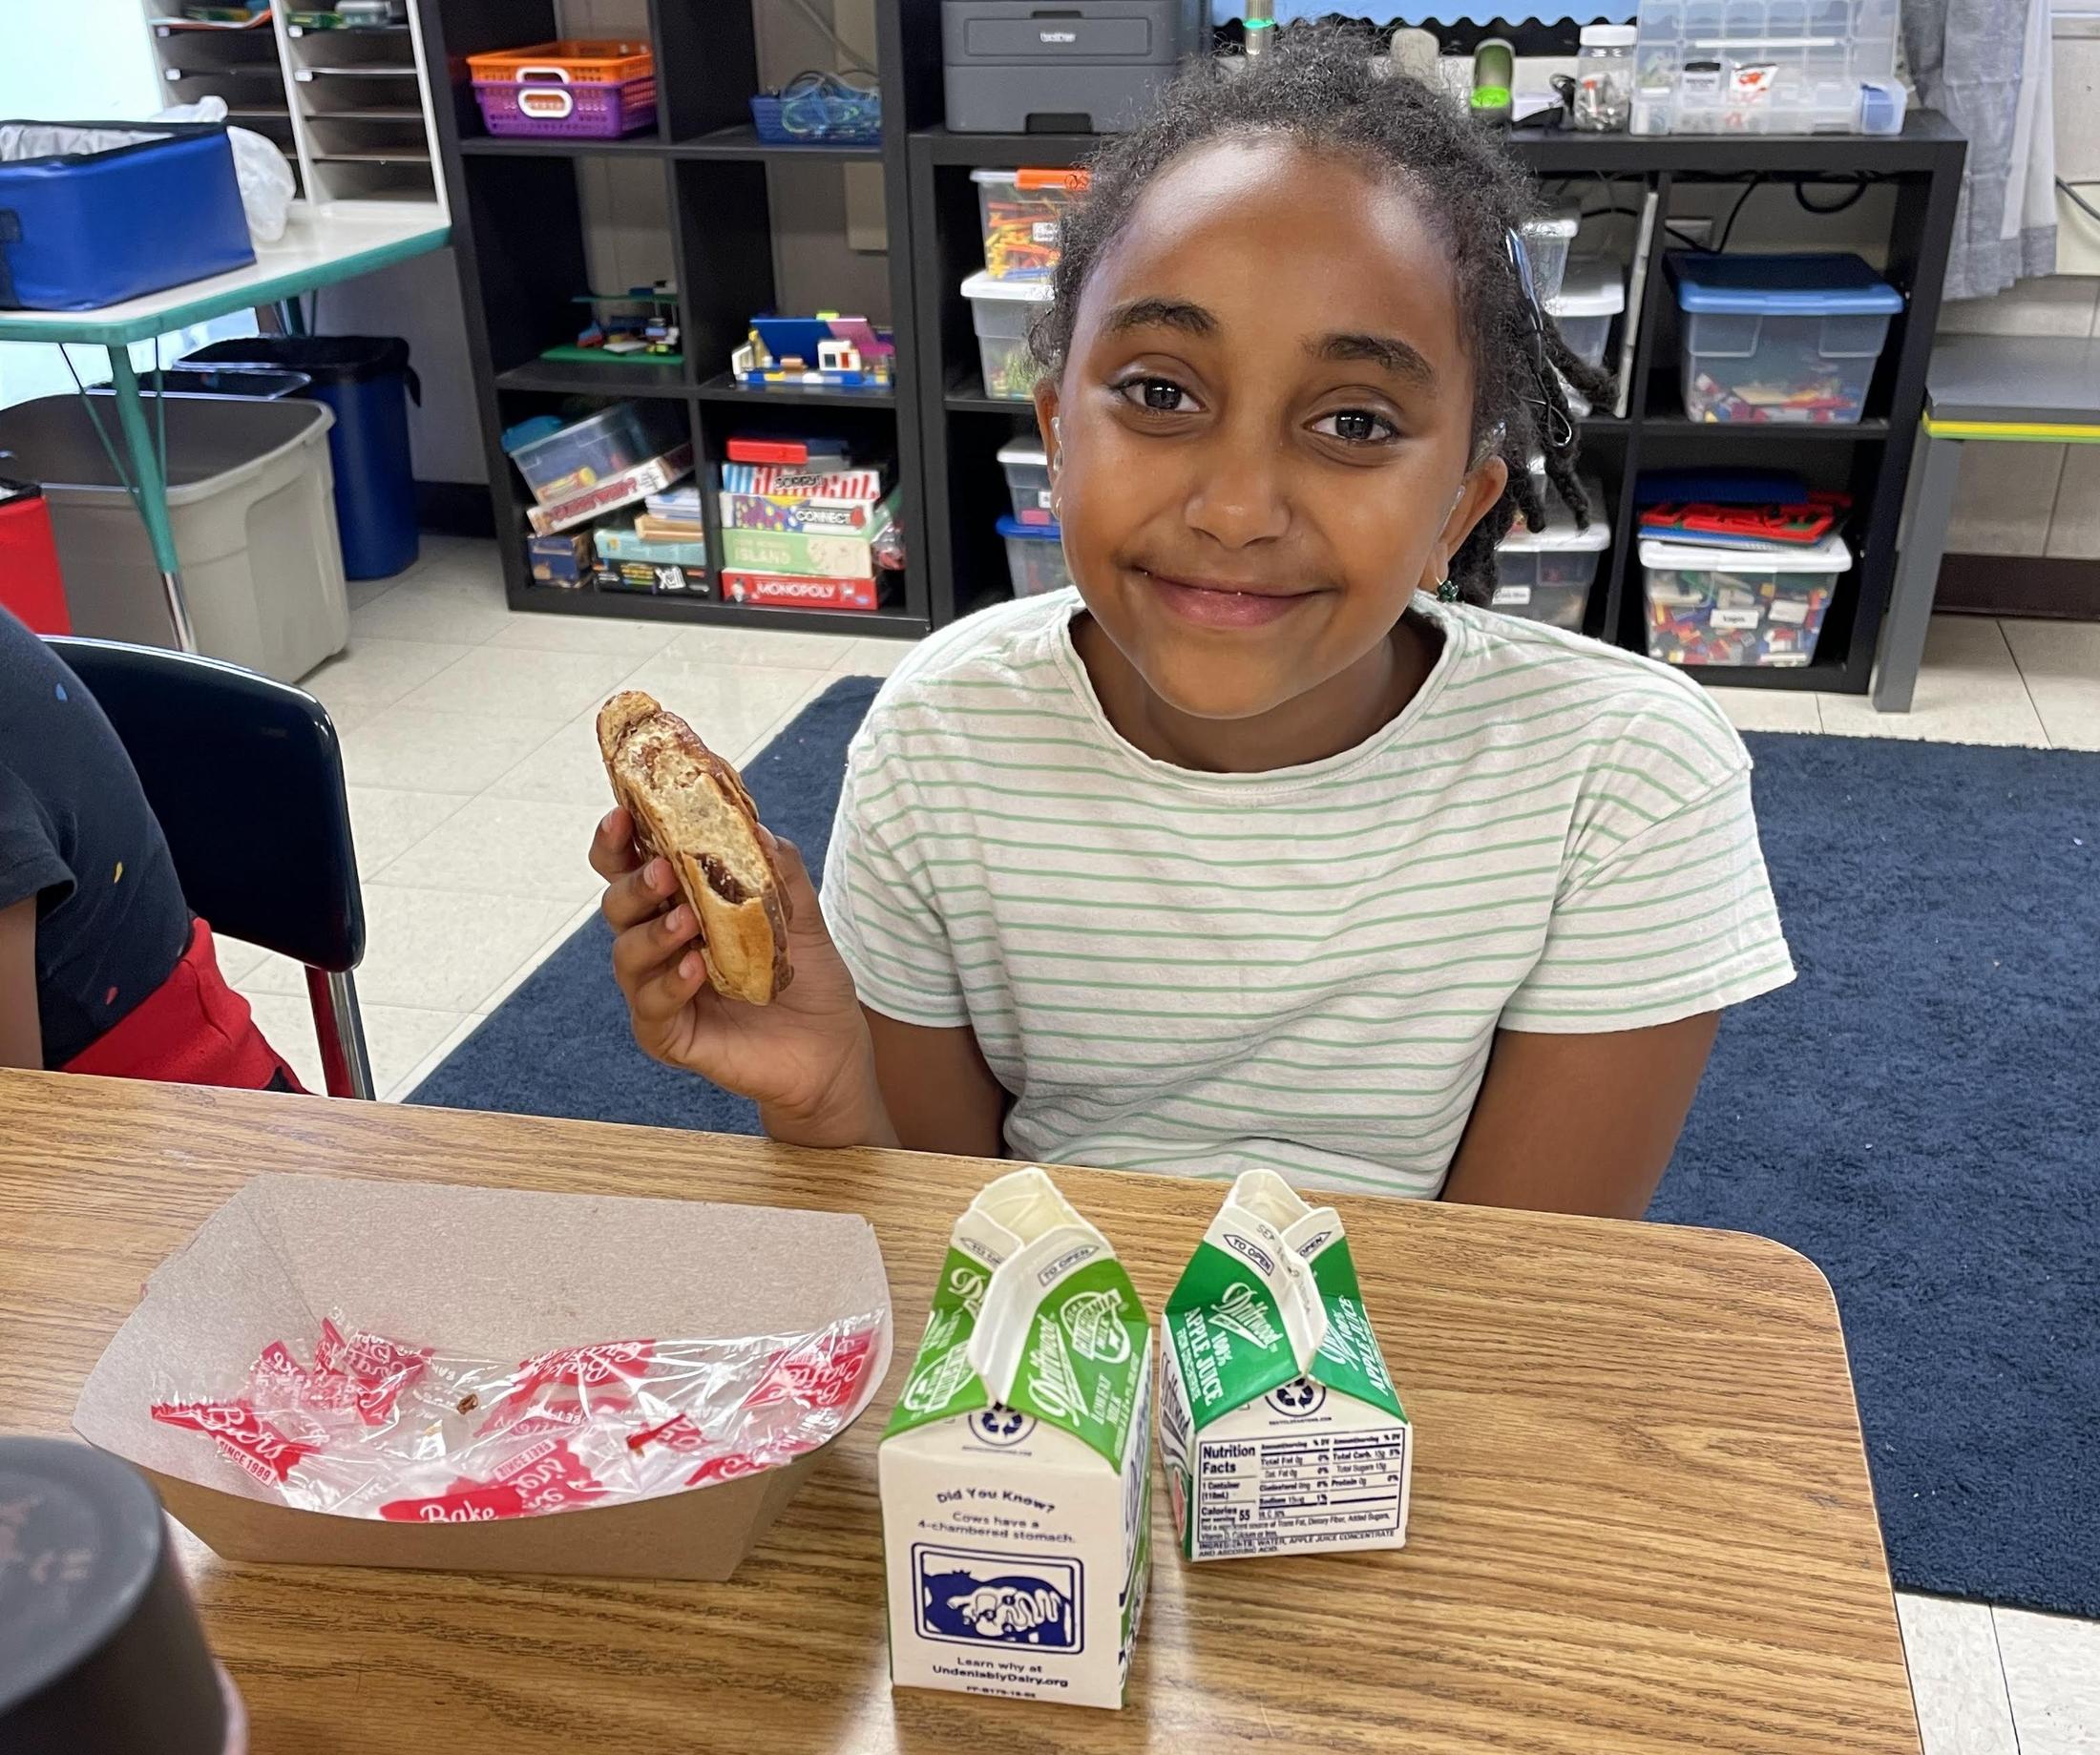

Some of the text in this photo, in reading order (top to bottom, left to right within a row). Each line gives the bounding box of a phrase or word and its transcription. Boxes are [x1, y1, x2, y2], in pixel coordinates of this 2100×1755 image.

[795, 510, 851, 525] CONNECT
[734, 547, 791, 566] ISLAND
[755, 582, 836, 598] MONOPOLY
[1234, 1239, 1247, 1250] TO
[1248, 1247, 1271, 1271] OPEN
[1299, 1236, 1322, 1257] OPEN
[1338, 1296, 1367, 1342] JUICE
[1184, 1306, 1224, 1407] APPLE JUICE
[1355, 1337, 1389, 1397] APPLE
[1203, 1443, 1256, 1460] Nutrition
[1334, 1452, 1352, 1461] Total
[219, 1440, 272, 1482] SINCE 1989
[1203, 1462, 1237, 1474] Facts
[1208, 1481, 1240, 1490] Container
[1332, 1478, 1357, 1487] Protein
[936, 1487, 1057, 1515] Did You Know?
[420, 1499, 497, 1522] Bake
[953, 1511, 990, 1525] Cows
[994, 1515, 1027, 1528] have
[1201, 1507, 1238, 1515] Calories
[1239, 1509, 1250, 1521] 55
[917, 1519, 1077, 1544] 4-chambered stomach.
[1315, 1534, 1338, 1543] JUICE
[956, 1656, 1043, 1674] Learn why at
[932, 1664, 1069, 1689] UndeniablyDairy.org
